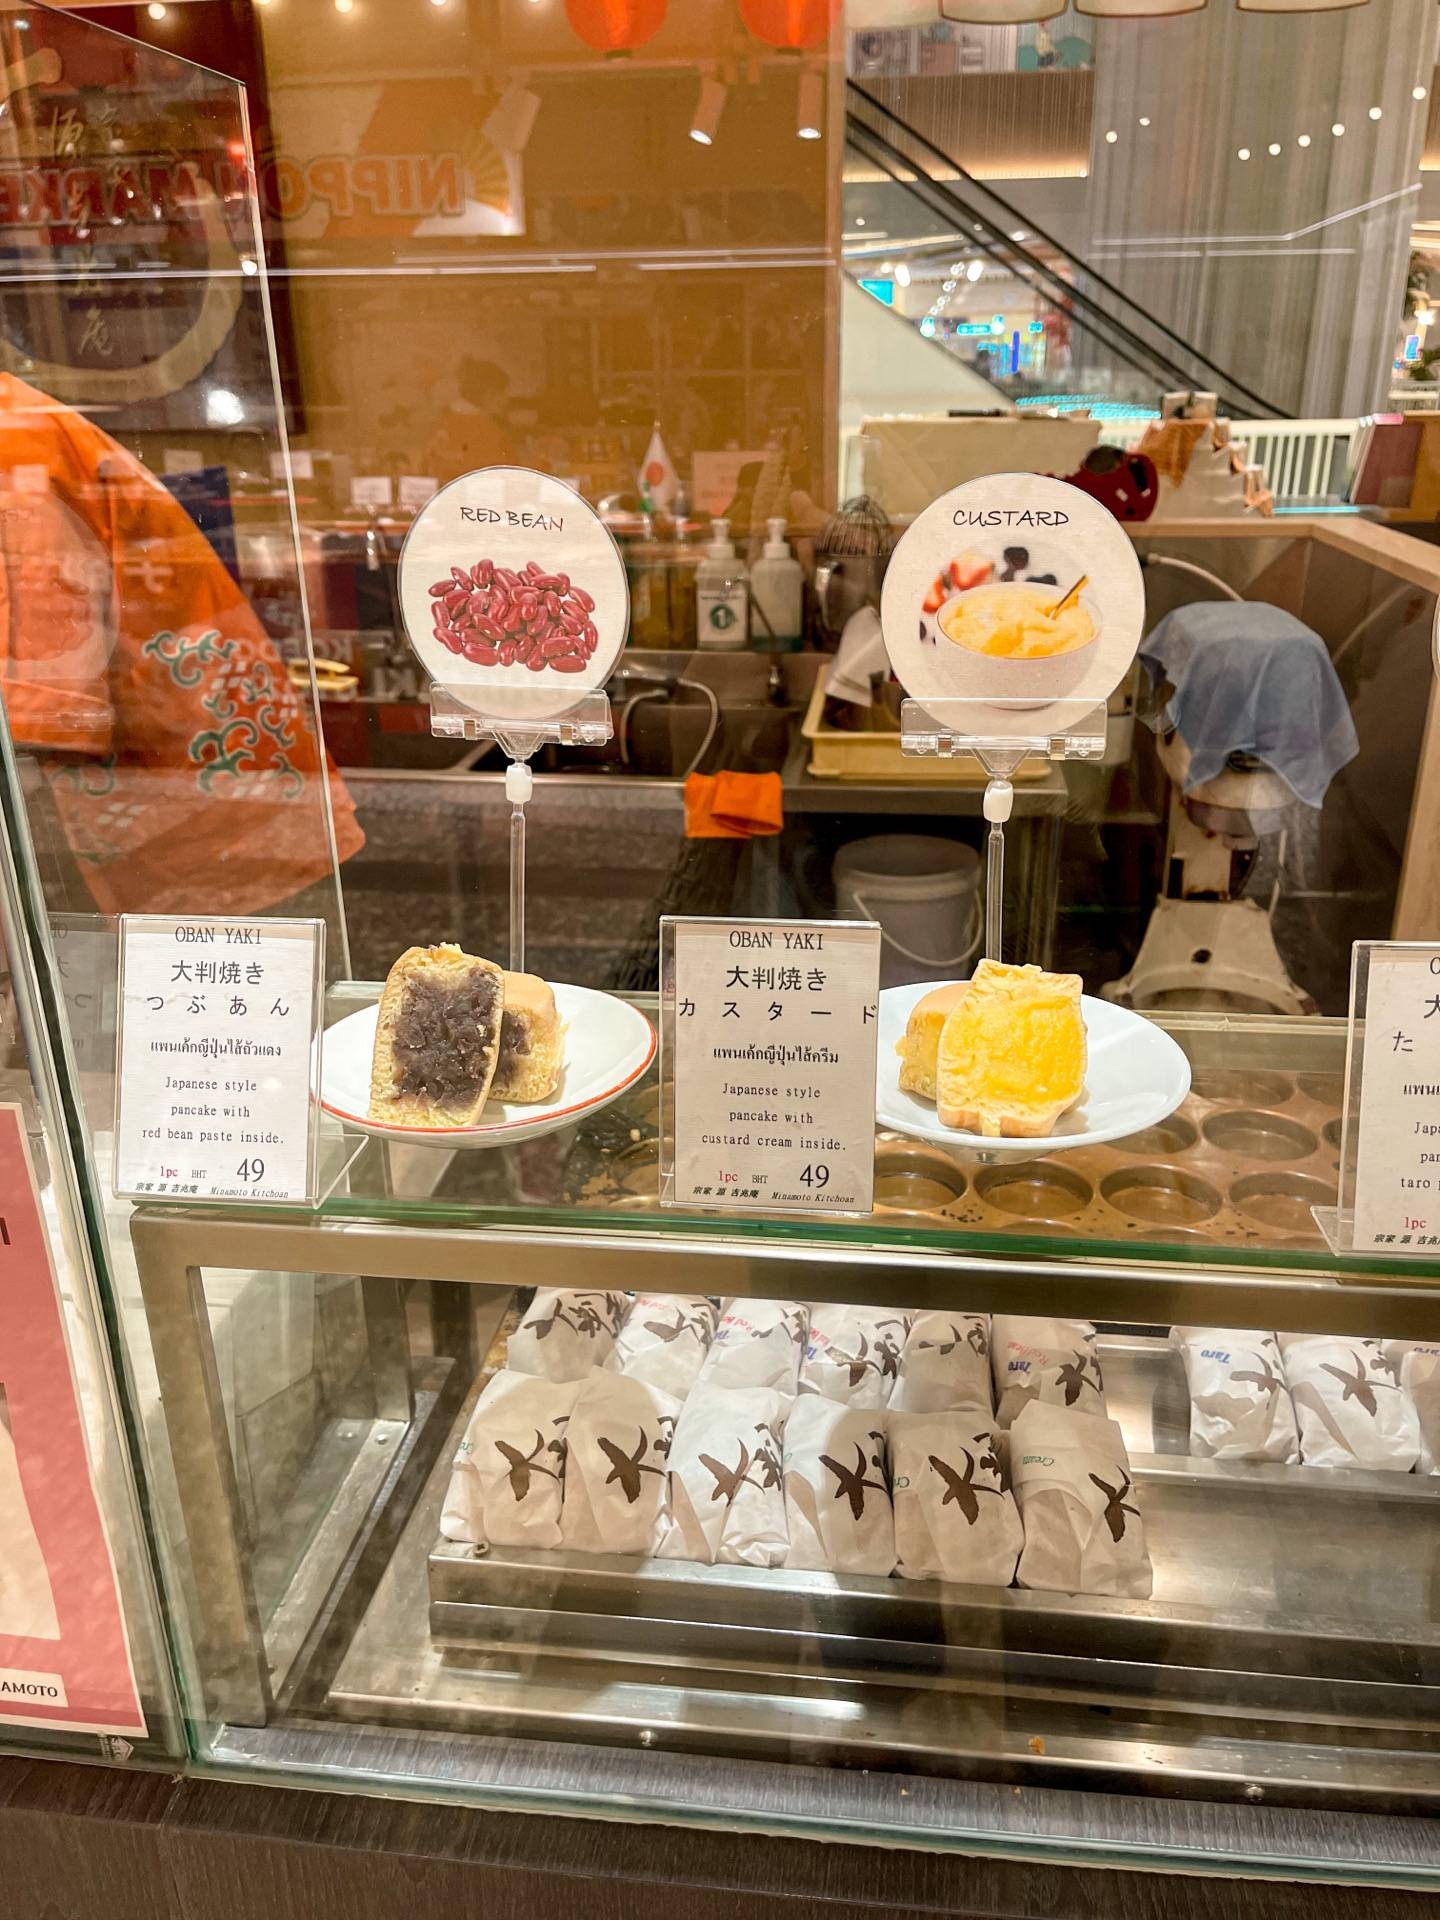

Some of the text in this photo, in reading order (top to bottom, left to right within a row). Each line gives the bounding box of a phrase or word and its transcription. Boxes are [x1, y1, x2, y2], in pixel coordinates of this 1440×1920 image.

[460, 507, 563, 531] RED BEAN
[953, 510, 1069, 527] CUSTARD
[175, 926, 262, 945] OBAN YAKI
[729, 930, 824, 950] OBAN YAKI
[171, 960, 265, 985] 大判焼き
[725, 965, 827, 991] 大判焼き
[165, 1076, 257, 1092] Japanese style
[722, 1083, 821, 1098] Japanese style
[171, 1104, 250, 1118] pancake with
[729, 1110, 814, 1124] pancake with
[142, 1128, 284, 1144] red bean paste inside.
[702, 1134, 847, 1150] custard cream inside.
[159, 1165, 178, 1178] 1pc
[236, 1158, 265, 1182] 49
[719, 1164, 830, 1188] 1pc BHT 49
[1401, 1177, 1431, 1189] taro
[210, 1186, 289, 1198] Minamoto Kitchoan
[771, 1191, 855, 1204] Minamoto Kitchoan
[1404, 1216, 1427, 1231] 1pc
[1200, 1349, 1230, 1364] Taro
[1, 1681, 58, 1697] AMOTO
